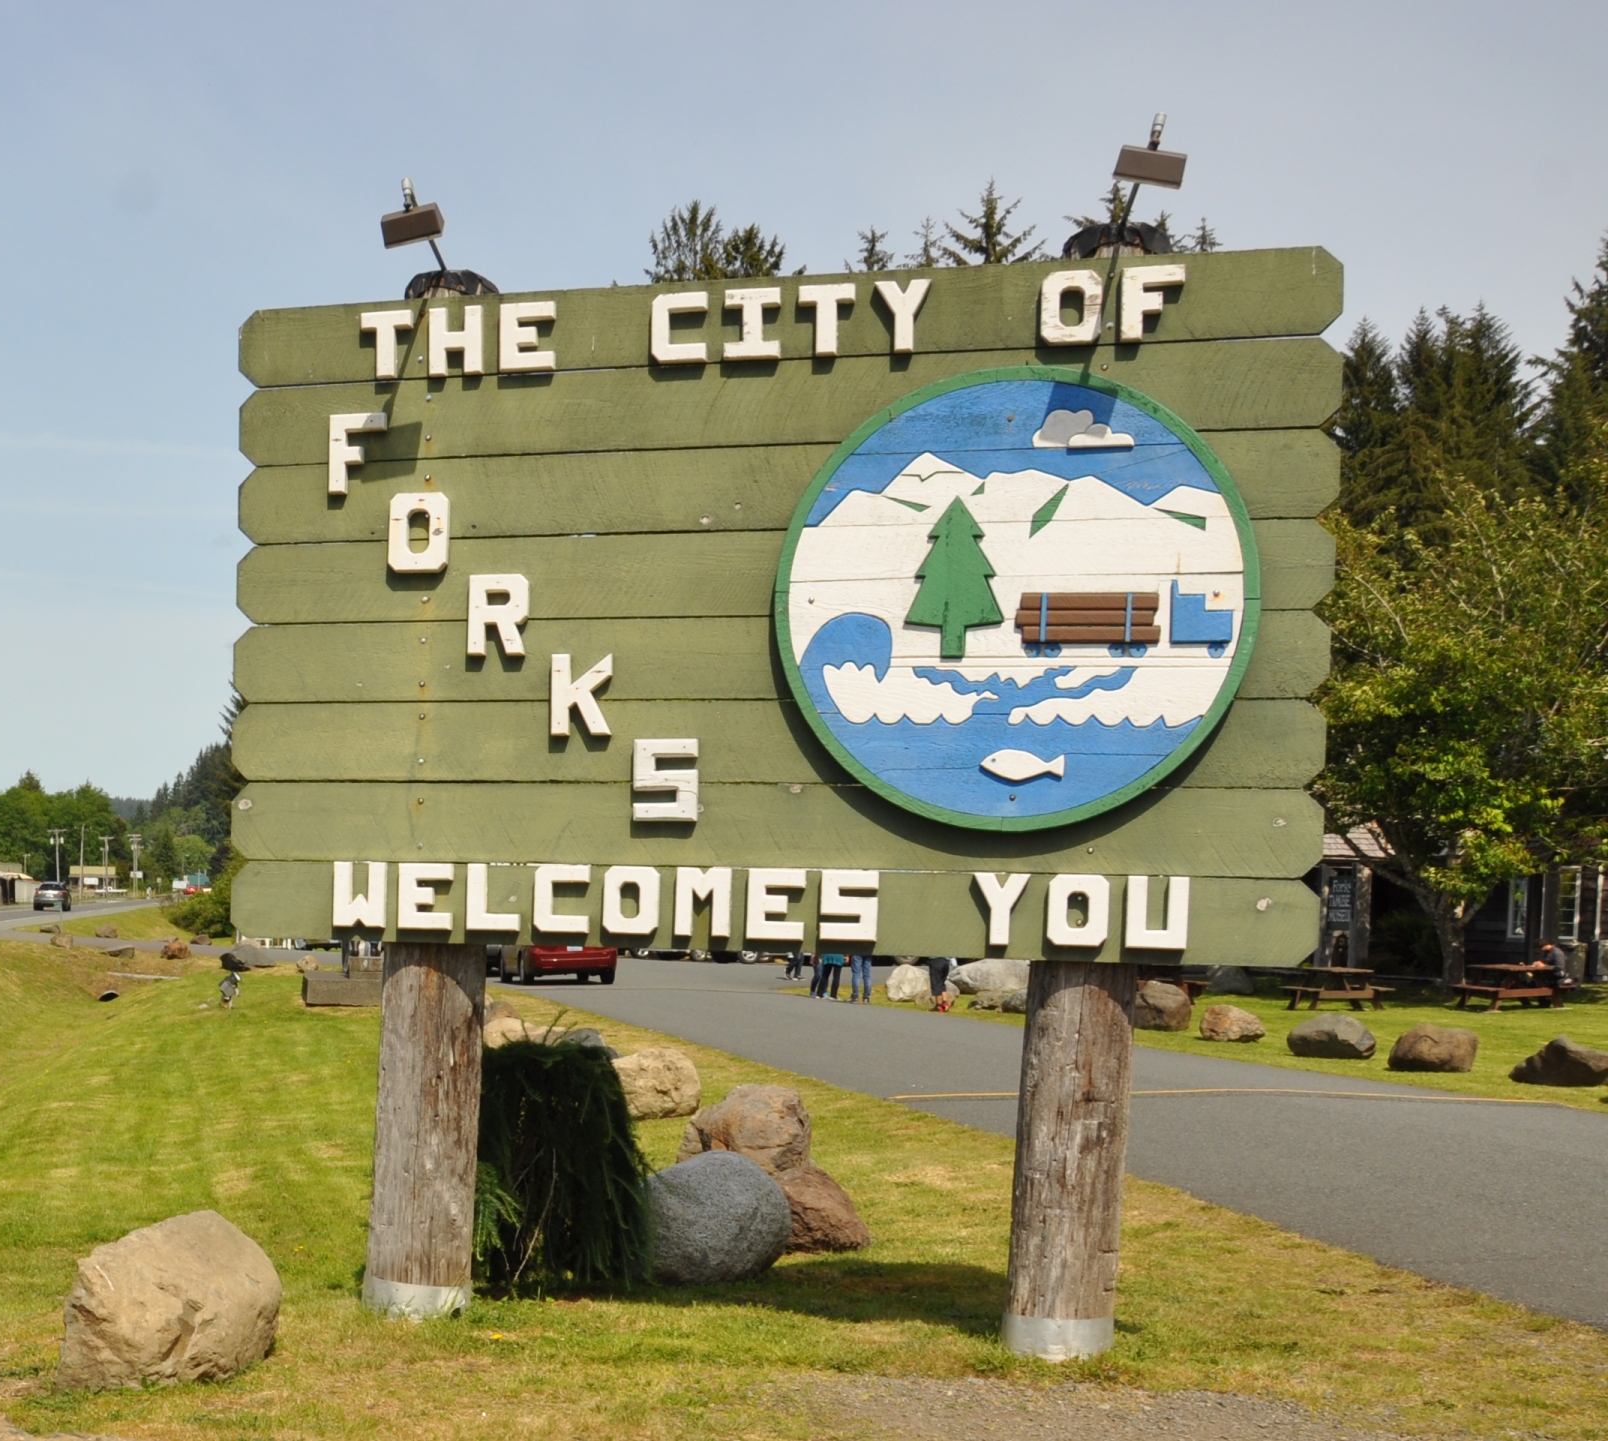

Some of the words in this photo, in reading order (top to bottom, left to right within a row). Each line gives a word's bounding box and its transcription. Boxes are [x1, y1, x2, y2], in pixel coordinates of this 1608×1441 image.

[360, 301, 556, 380] THE
[651, 279, 932, 364] CITY
[1041, 264, 1186, 345] OF
[328, 412, 699, 822] FORKS
[332, 861, 880, 942] WELCOMES
[974, 872, 1190, 950] YOU
[1328, 909, 1351, 922] MUSEU
[1329, 894, 1351, 907] TIMBE
